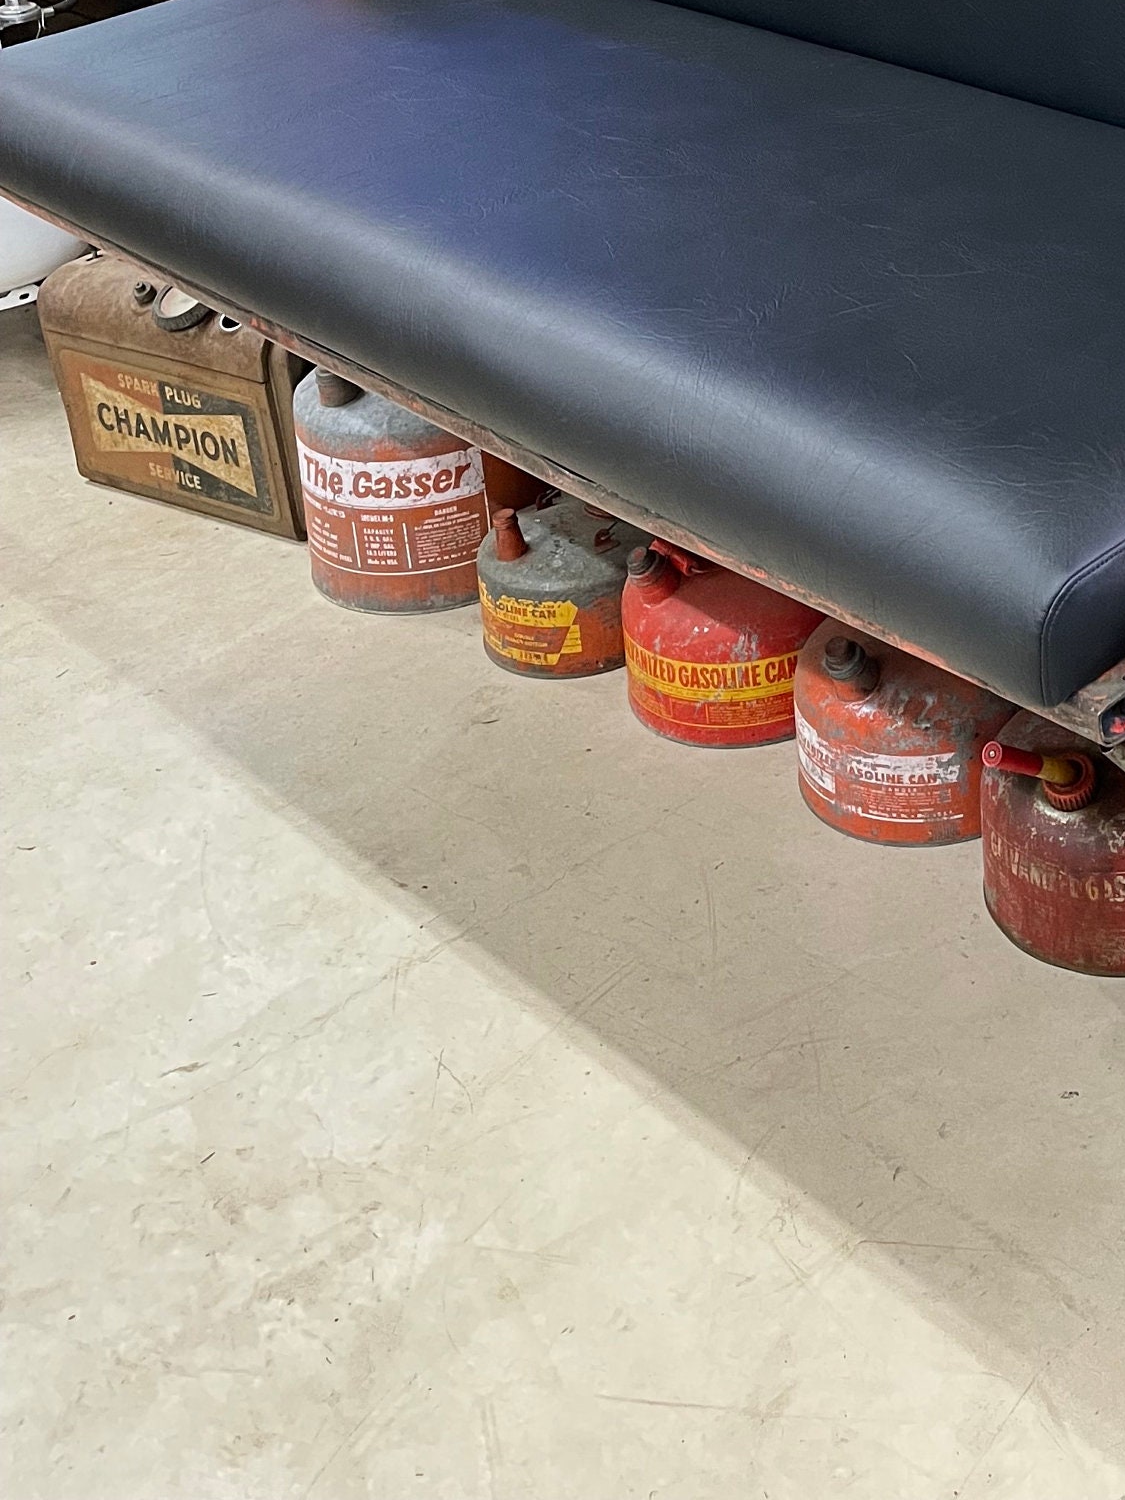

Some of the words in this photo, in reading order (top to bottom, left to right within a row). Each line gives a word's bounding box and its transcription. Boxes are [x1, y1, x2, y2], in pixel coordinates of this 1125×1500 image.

[117, 373, 159, 397] SPARK
[164, 385, 202, 410] PLUG
[97, 402, 240, 468] CHAMPION
[149, 462, 202, 490] SERVICE
[302, 452, 345, 495] The
[350, 462, 471, 502] Gasser
[531, 608, 557, 619] CAN
[678, 664, 761, 690] GASOLINE
[764, 655, 798, 684] CAN
[847, 765, 904, 784] ASOLINE
[909, 772, 938, 784] CAN
